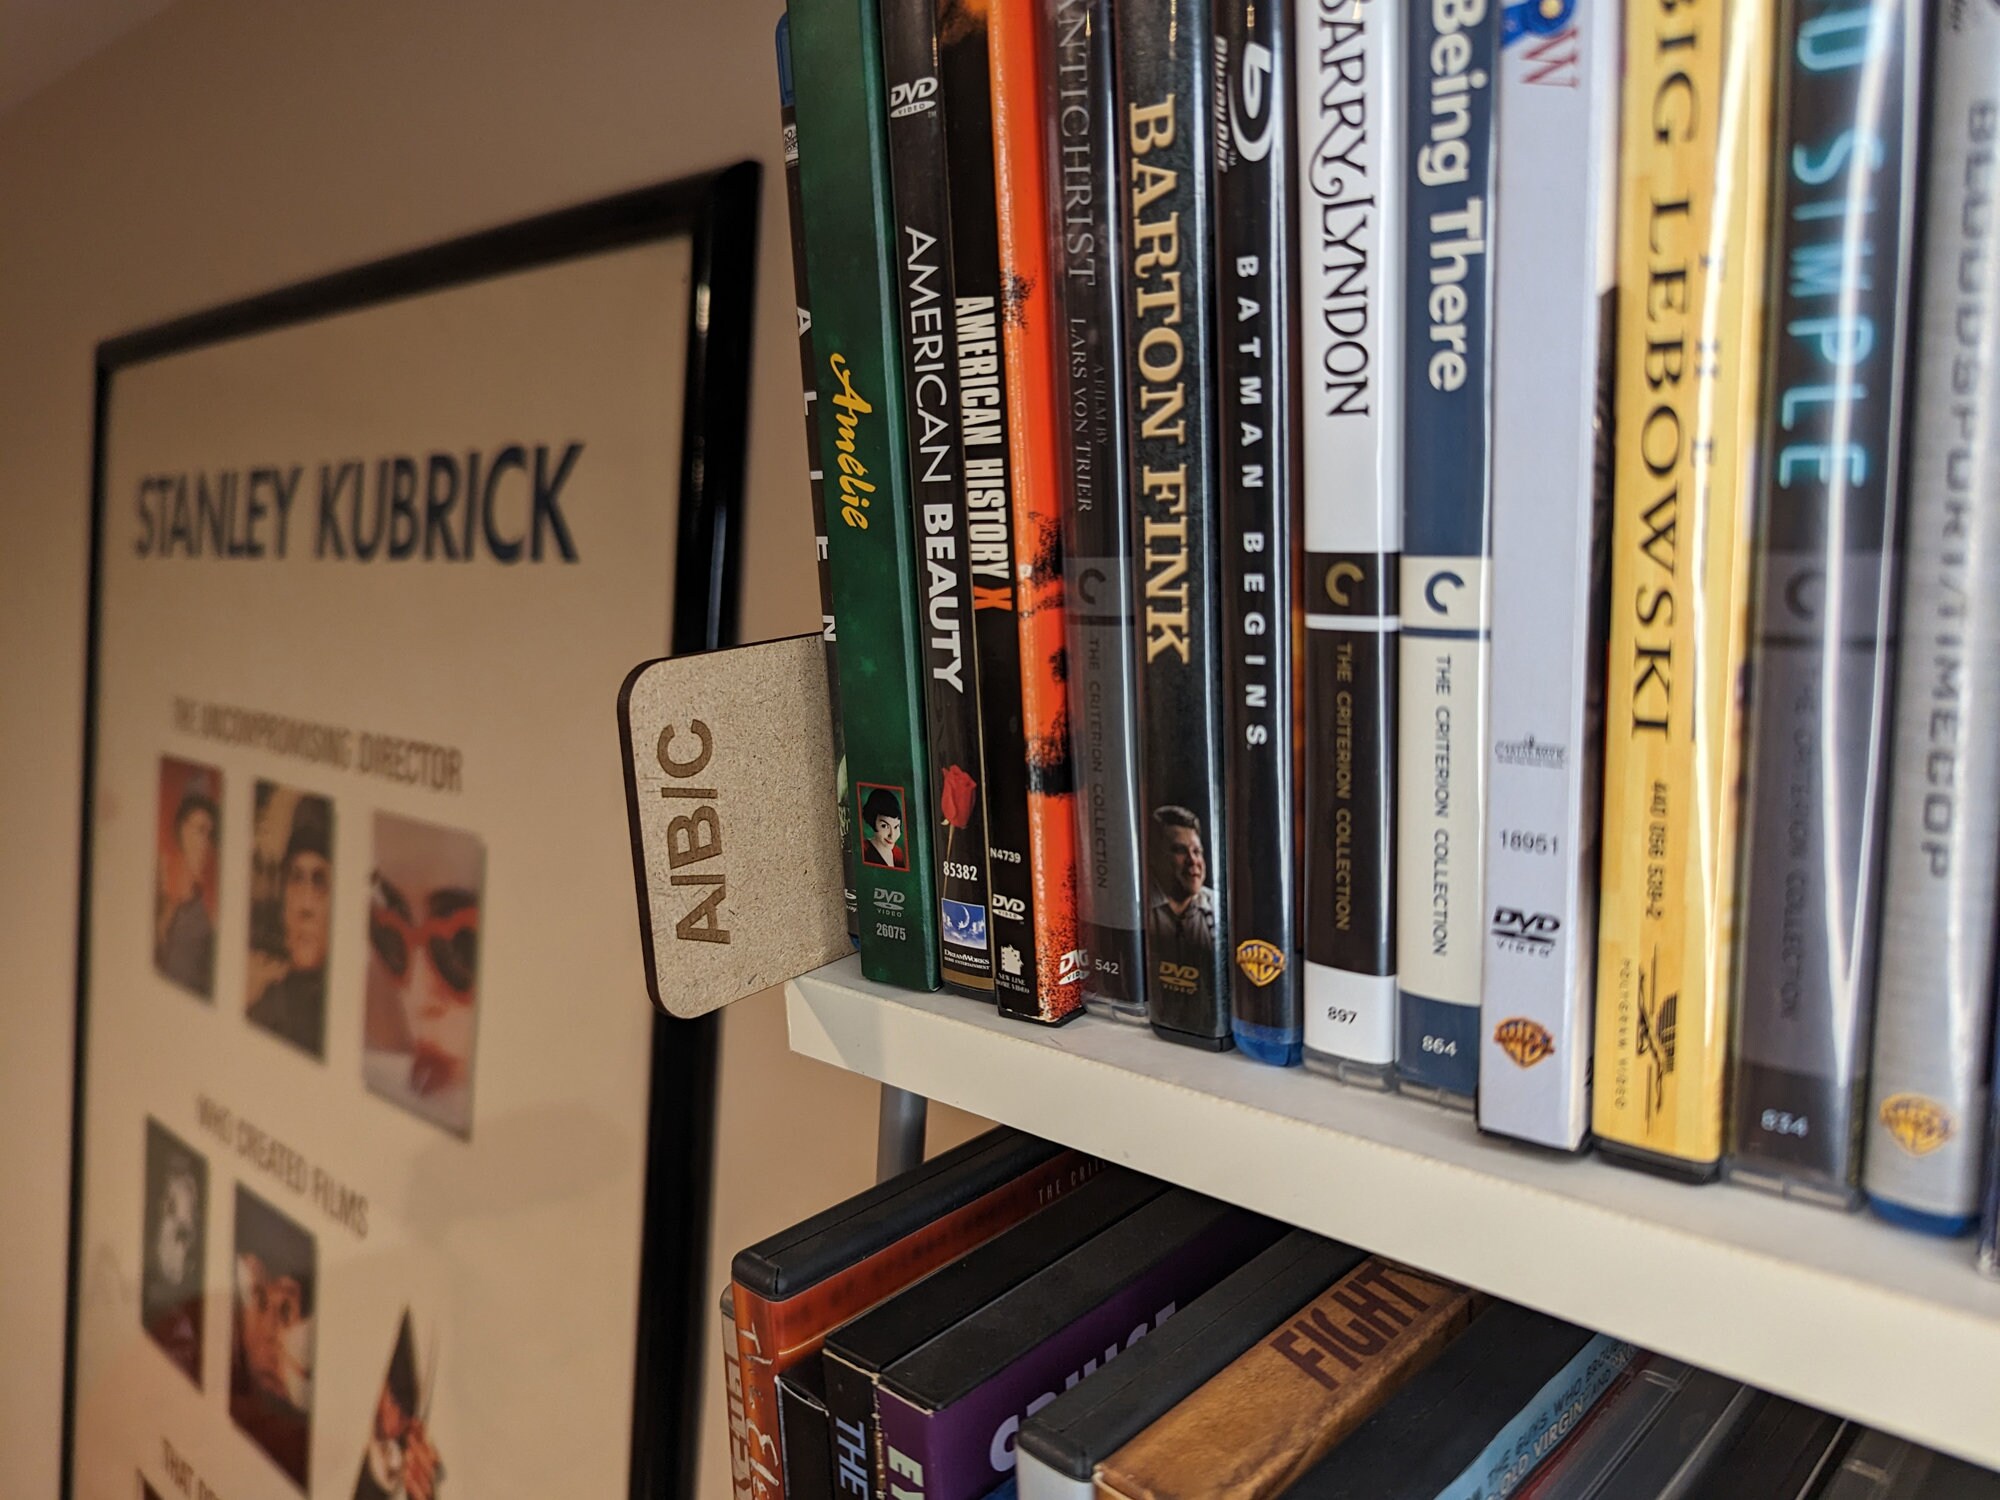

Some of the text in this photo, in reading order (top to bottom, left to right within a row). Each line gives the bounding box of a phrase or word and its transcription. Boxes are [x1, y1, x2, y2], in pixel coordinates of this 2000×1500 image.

[891, 77, 939, 108] DVD
[897, 102, 927, 116] VIDEO
[1418, 0, 1488, 392] Being There
[1322, 194, 1377, 418] LYNDON
[1779, 130, 1885, 488] SIMPLE
[1129, 93, 1190, 664] BARTON FINK
[1632, 0, 1697, 743] IG LEBOWSKI
[1071, 318, 1092, 512] LARS VON TRIER
[905, 225, 964, 694] AMERICAN BEAUTY
[955, 296, 1013, 611] AMERICAN HISTORY X
[134, 442, 585, 565] STANLEY KUBRICK
[1236, 255, 1268, 747] BATMAN BEGINS
[1091, 681, 1103, 773] CRITERION
[357, 731, 465, 794] DIRECTOR
[1336, 642, 1353, 932] THE CRITERION COLLECTION
[1093, 783, 1108, 888] COLLECTION
[1432, 654, 1452, 957] THE CRITERION COLLECTION
[943, 860, 978, 881] 85382
[990, 847, 1021, 864] N4739
[1499, 828, 1559, 857] 18951
[873, 887, 906, 903] DVD
[877, 908, 902, 918] VIDEO
[992, 893, 1026, 913] DVD
[1493, 906, 1560, 936] DVD
[876, 922, 906, 941] 26075
[1095, 959, 1119, 975] 542
[1160, 961, 1199, 980] DVD
[1327, 1006, 1358, 1025] 897
[1421, 1035, 1458, 1057] 864
[235, 1116, 308, 1197] CREATED
[312, 1165, 369, 1240] FILMS
[1038, 1179, 1062, 1205] THE
[1270, 1261, 1436, 1391] FIGHT
[1533, 1396, 1585, 1458] VIRGIN
